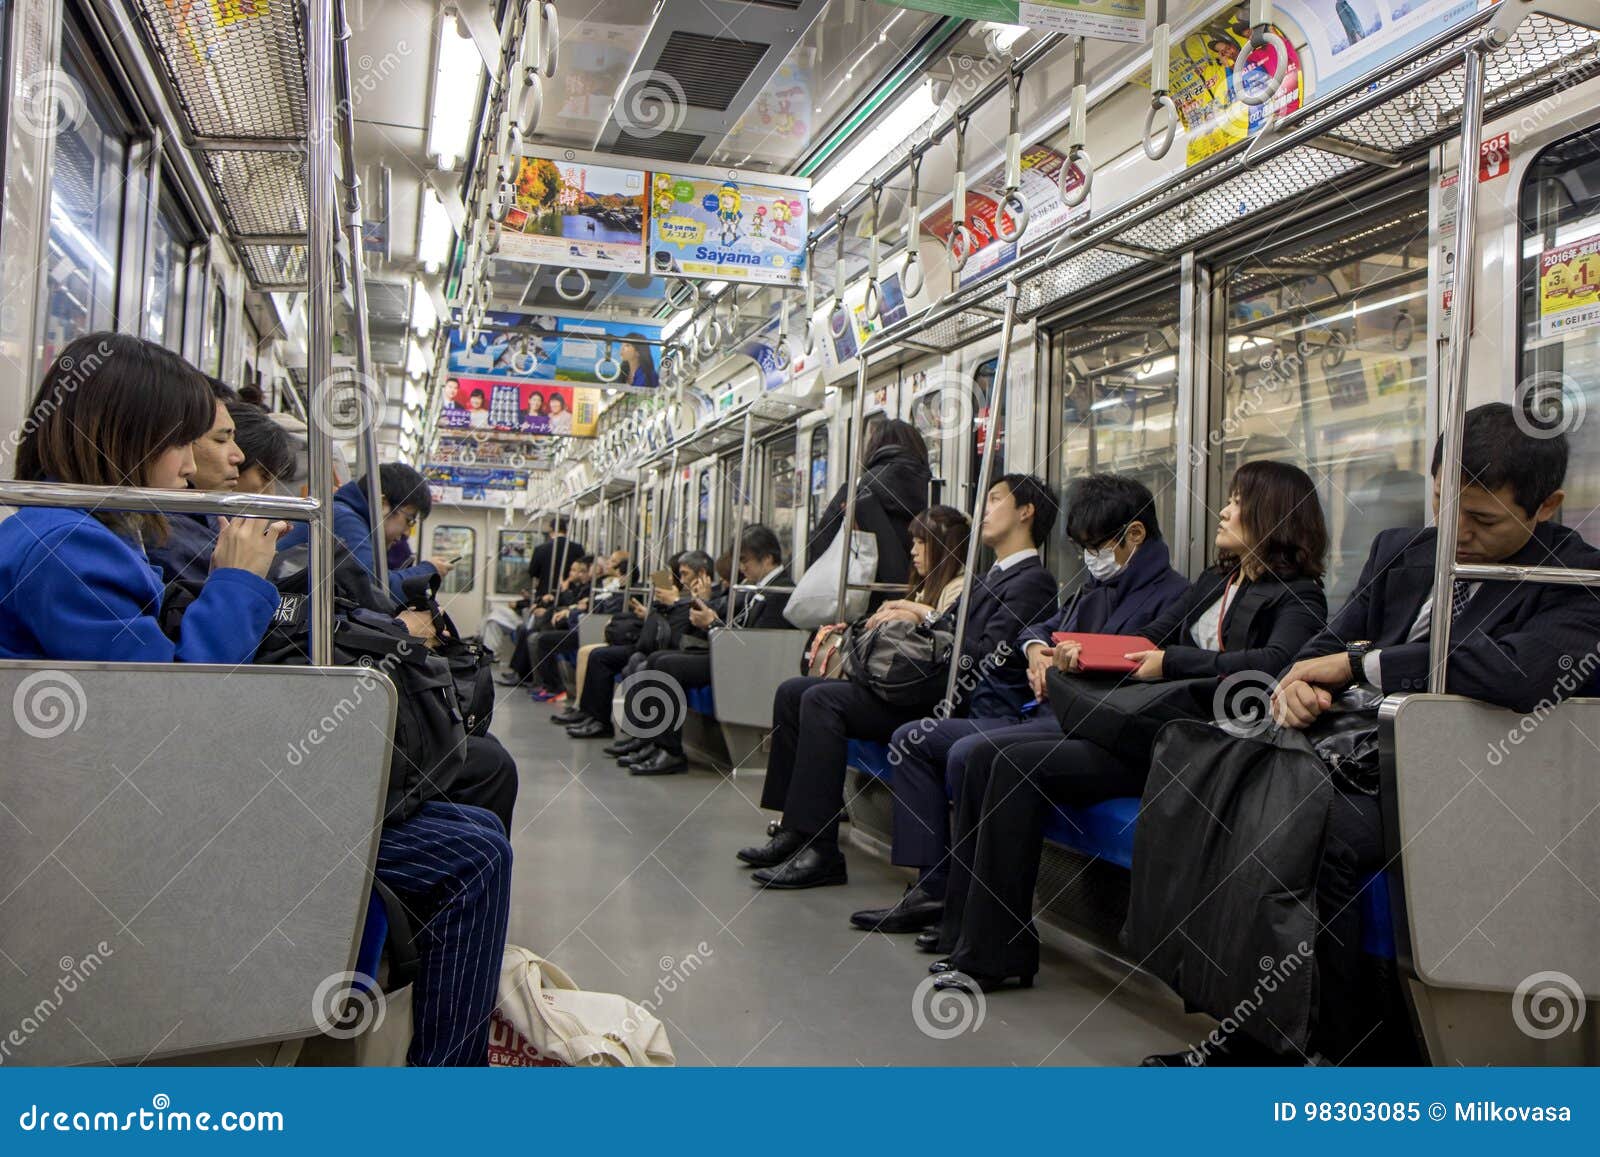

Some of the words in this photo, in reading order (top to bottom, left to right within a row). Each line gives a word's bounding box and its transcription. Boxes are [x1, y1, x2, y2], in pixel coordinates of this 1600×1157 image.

[1481, 135, 1508, 156] SOS
[662, 221, 697, 232] Sayama
[695, 246, 760, 265] Sayama
